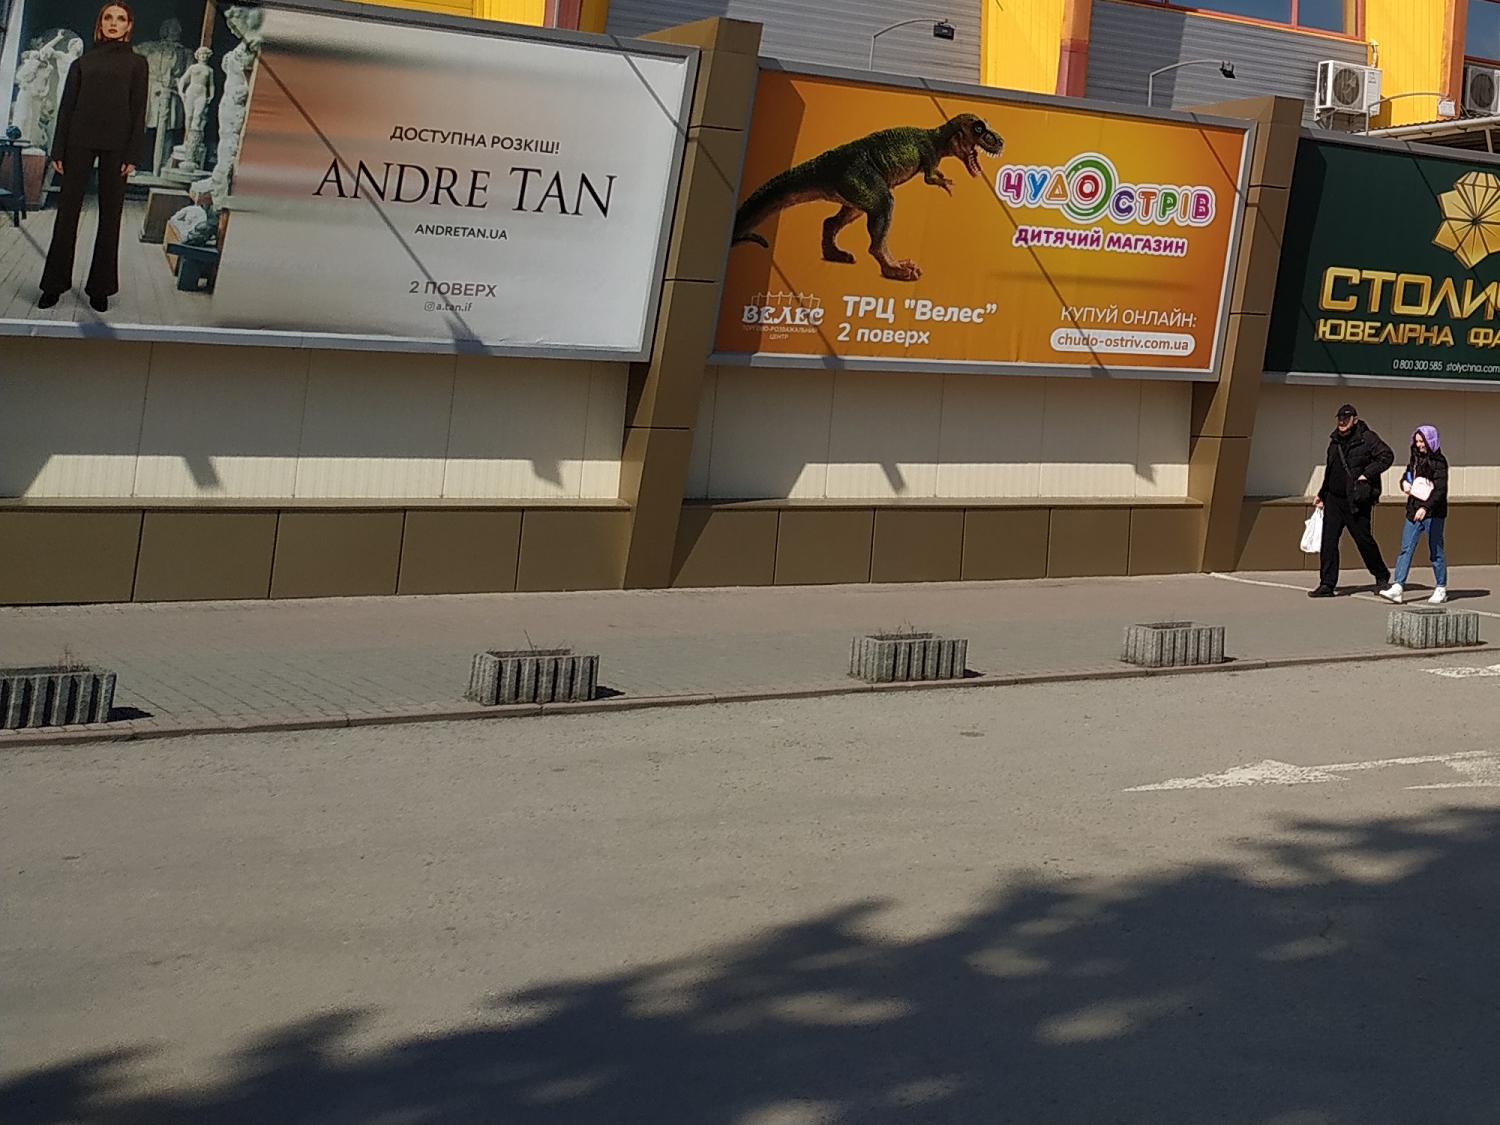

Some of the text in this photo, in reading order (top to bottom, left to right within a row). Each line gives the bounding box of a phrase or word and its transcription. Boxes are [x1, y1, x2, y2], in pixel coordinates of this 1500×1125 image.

[390, 125, 560, 155] ДОСТУПНА РОЗКІШ!
[312, 157, 618, 219] ANDRE TAN
[415, 223, 508, 241] ANDRETAN.UA
[1014, 226, 1187, 255] ДИТЯЧИЙ МАГАЗИН
[409, 280, 498, 298] 2 ПОВЕРХ
[742, 304, 824, 325] ВЕЛЕС
[842, 295, 894, 323] ТРЦ
[1060, 304, 1198, 328] КУПУЙ ОНЛАЙН:
[837, 323, 931, 347] 2 поверх
[1057, 332, 1189, 351] chudo-ostriv.com.ua
[1315, 318, 1454, 347] ЮВЕЛІРНА
